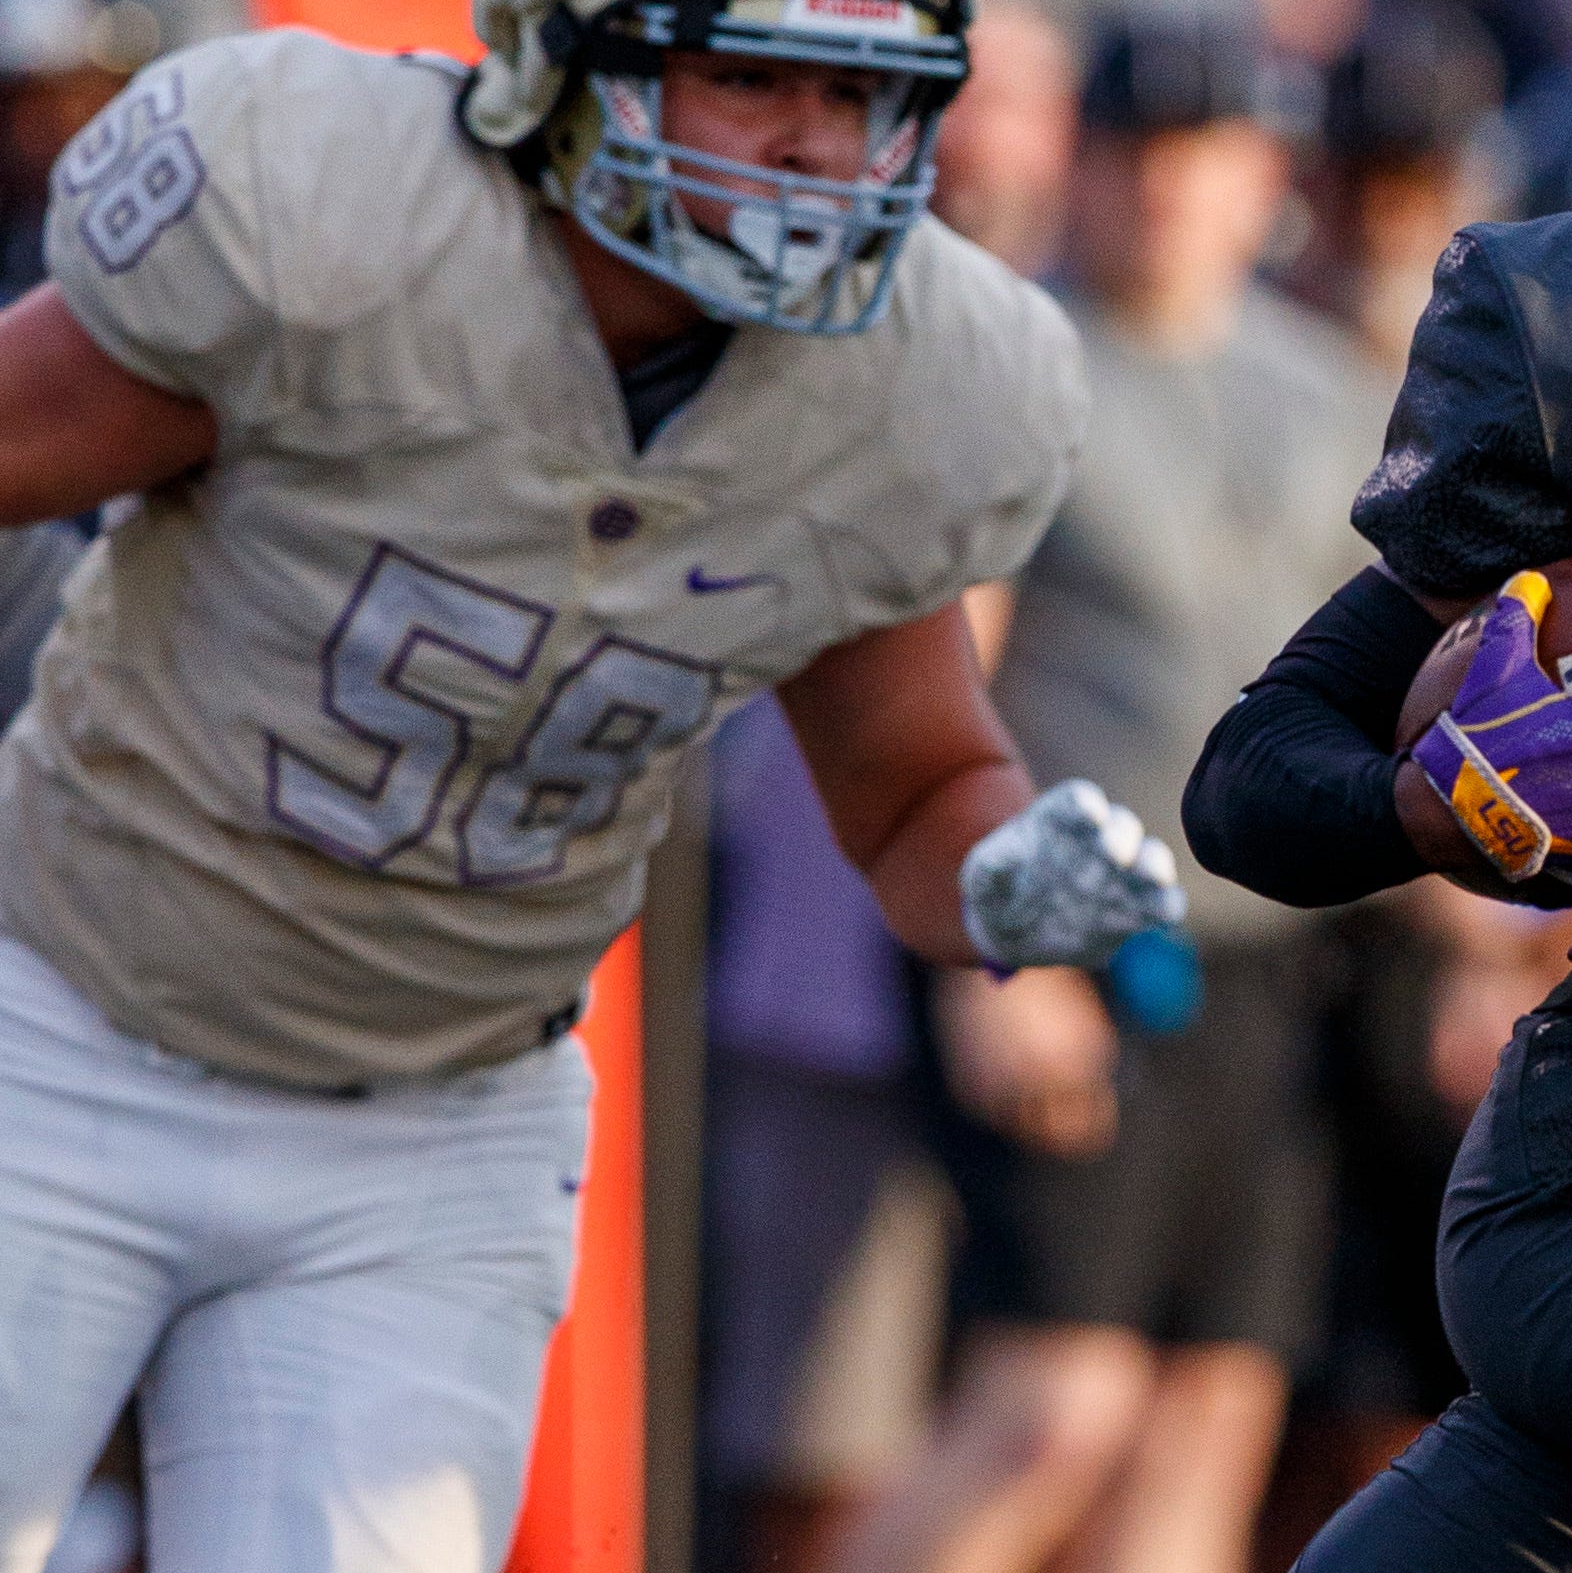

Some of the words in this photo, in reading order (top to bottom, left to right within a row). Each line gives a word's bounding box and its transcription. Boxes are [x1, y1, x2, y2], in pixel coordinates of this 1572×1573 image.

[58, 66, 206, 274] 58
[265, 540, 722, 886] 58
[1478, 799, 1536, 856] LSU
